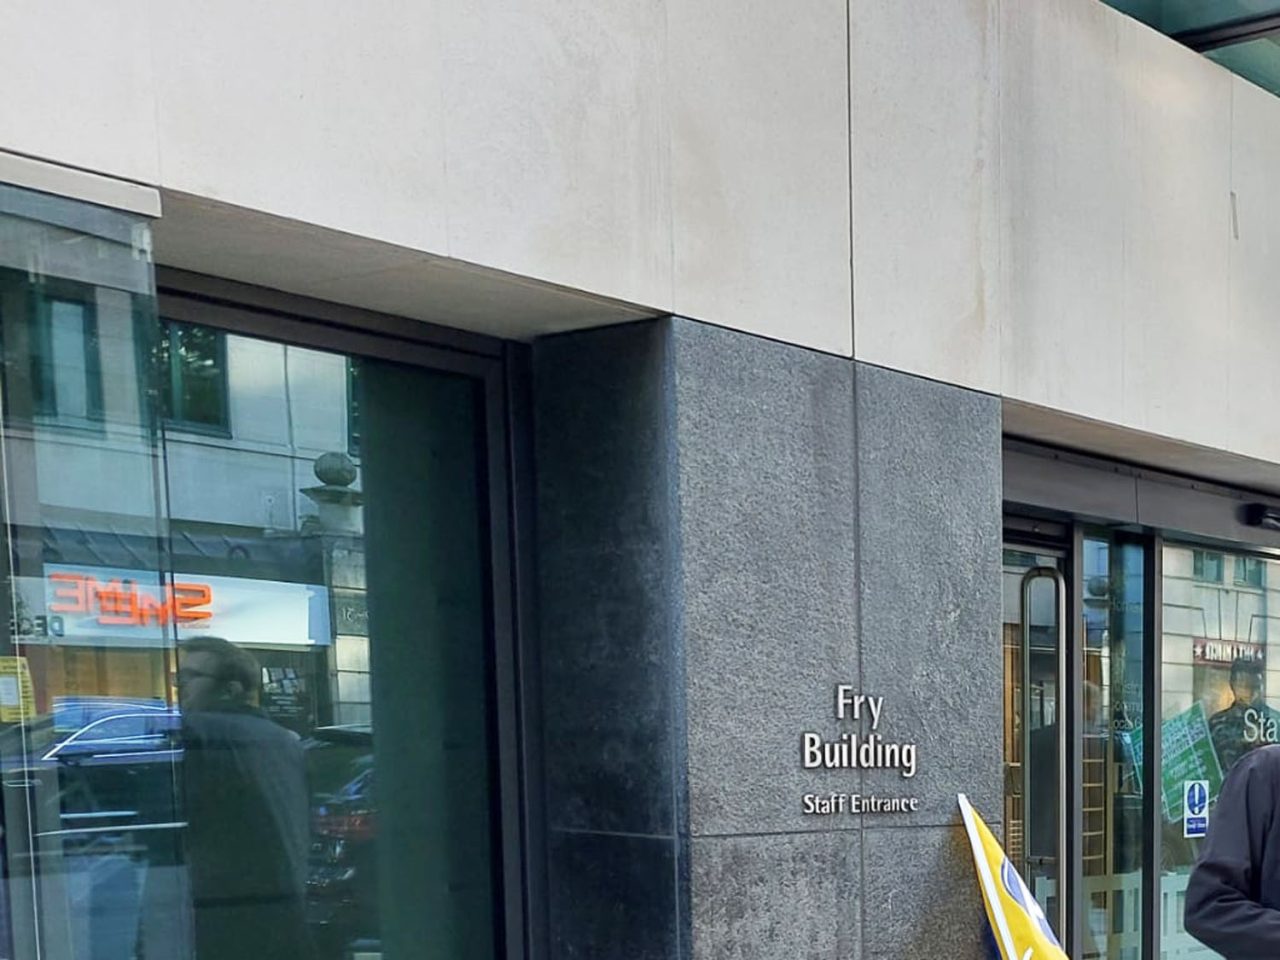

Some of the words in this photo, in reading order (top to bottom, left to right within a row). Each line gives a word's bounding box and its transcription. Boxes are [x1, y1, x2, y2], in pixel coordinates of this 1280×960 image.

[836, 684, 884, 730] Fry
[803, 732, 917, 777] Building
[803, 794, 846, 814] Staff
[851, 794, 919, 813] Entrance
